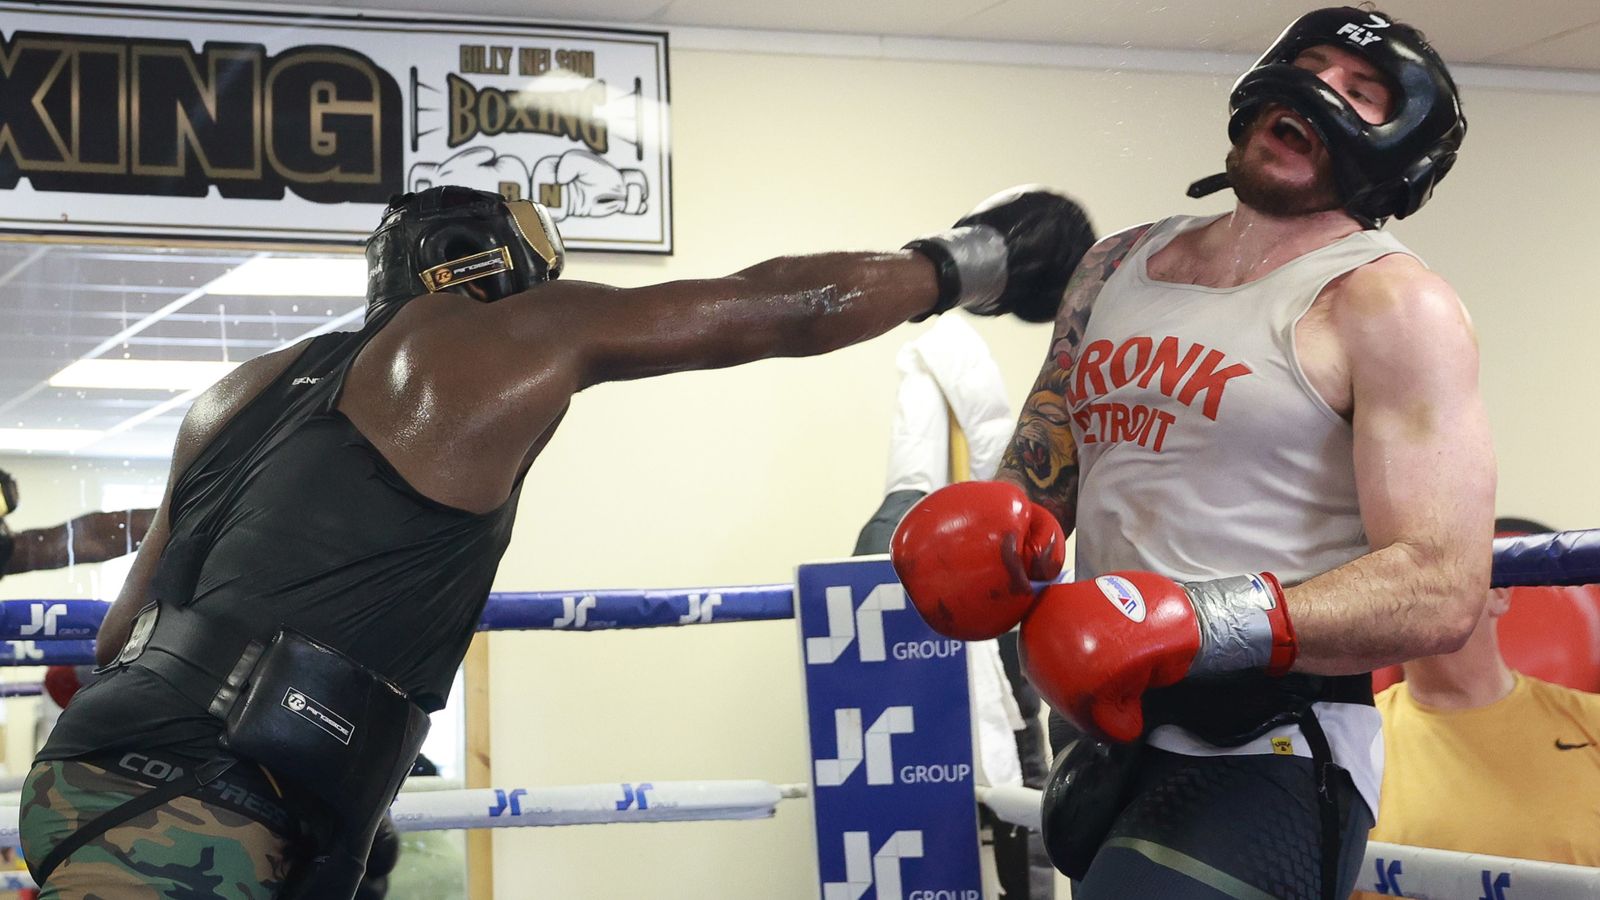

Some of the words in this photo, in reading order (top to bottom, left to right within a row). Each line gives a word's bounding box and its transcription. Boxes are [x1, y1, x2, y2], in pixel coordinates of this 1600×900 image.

[1336, 22, 1382, 47] FLY
[459, 45, 513, 75] BILLY
[519, 47, 595, 78] NELSON
[447, 73, 608, 153] BOXING
[1067, 336, 1253, 421] RONK
[1073, 402, 1176, 453] ETROIT
[893, 640, 962, 660] GROUP
[900, 764, 970, 784] GROUP
